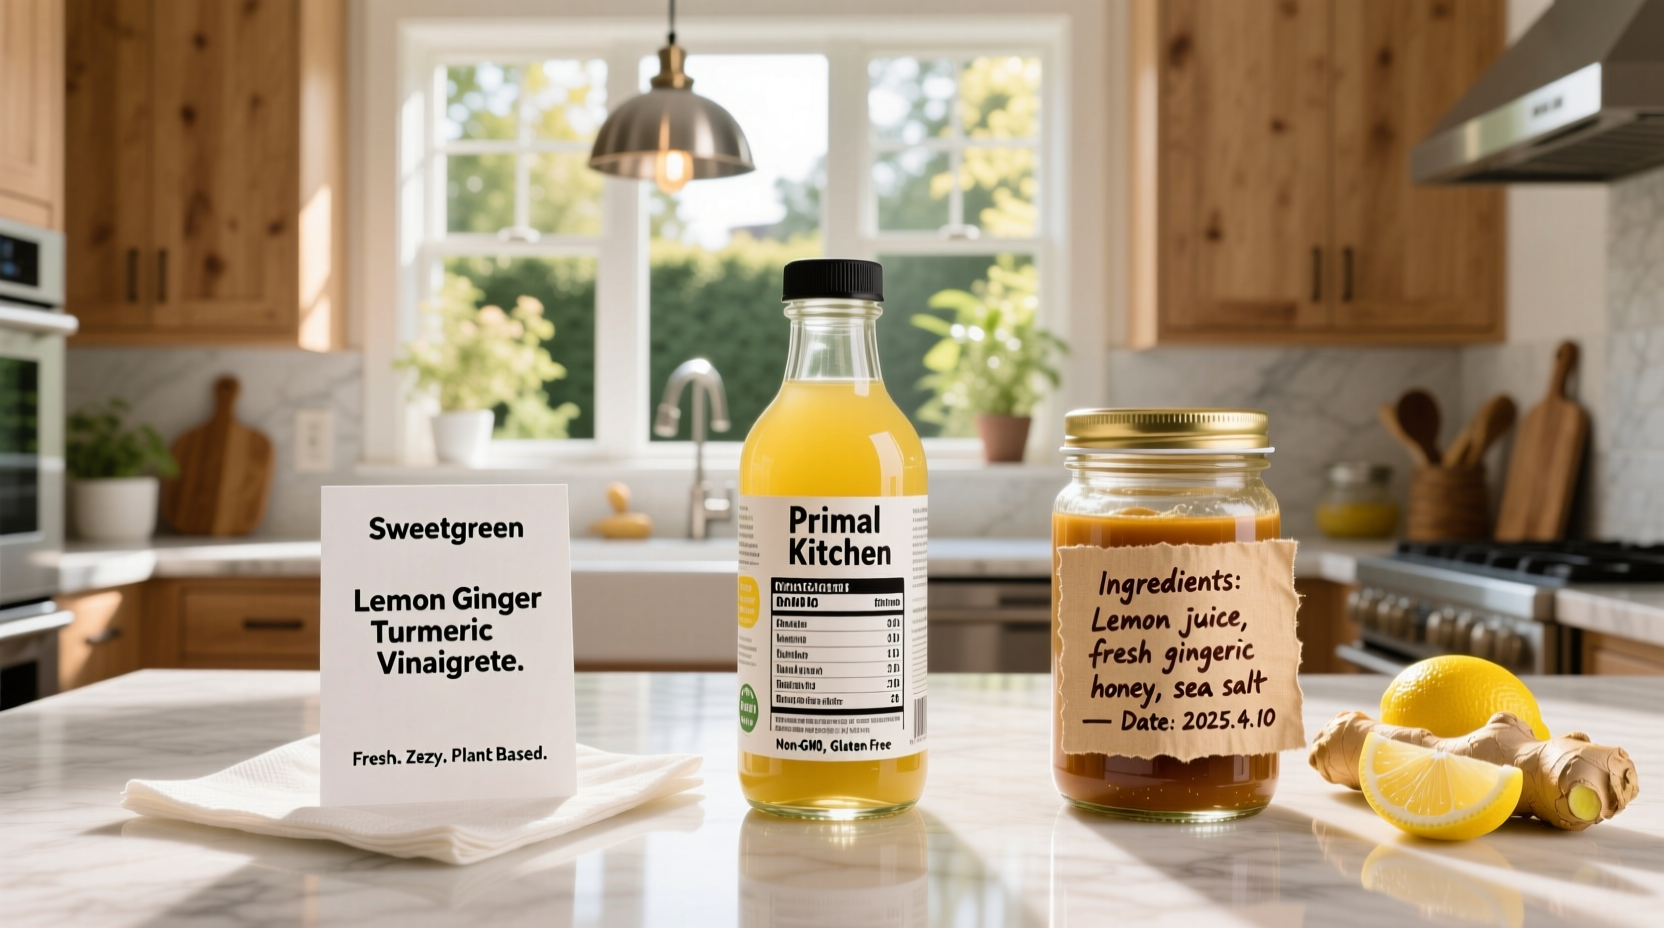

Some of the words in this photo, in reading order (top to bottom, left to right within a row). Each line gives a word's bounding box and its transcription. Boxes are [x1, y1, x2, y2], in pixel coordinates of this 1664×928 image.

[369, 516, 524, 546] Sweetgreen
[789, 504, 880, 534] Primal
[789, 537, 891, 566] Kitchen
[354, 588, 446, 613] Lemon
[452, 585, 543, 616] Ginger
[1098, 566, 1241, 606] Ingredients:
[370, 616, 494, 644] Turmeric
[1091, 606, 1171, 633] Lemon
[1178, 605, 1247, 639] juice,
[376, 648, 524, 680] Vinaigrete.
[1088, 637, 1152, 670] fresh
[1161, 637, 1256, 675] gingeric
[1090, 673, 1163, 709] honey,
[1173, 680, 1214, 699] sea
[1222, 669, 1268, 697] salt
[1121, 707, 1175, 732] Date:
[1181, 707, 1276, 731] 2025.4.10
[352, 749, 402, 767] Fresh.
[405, 749, 448, 768] Zezy.
[451, 746, 494, 763] Plant
[495, 745, 548, 762] Based.
[869, 738, 892, 751] Free
